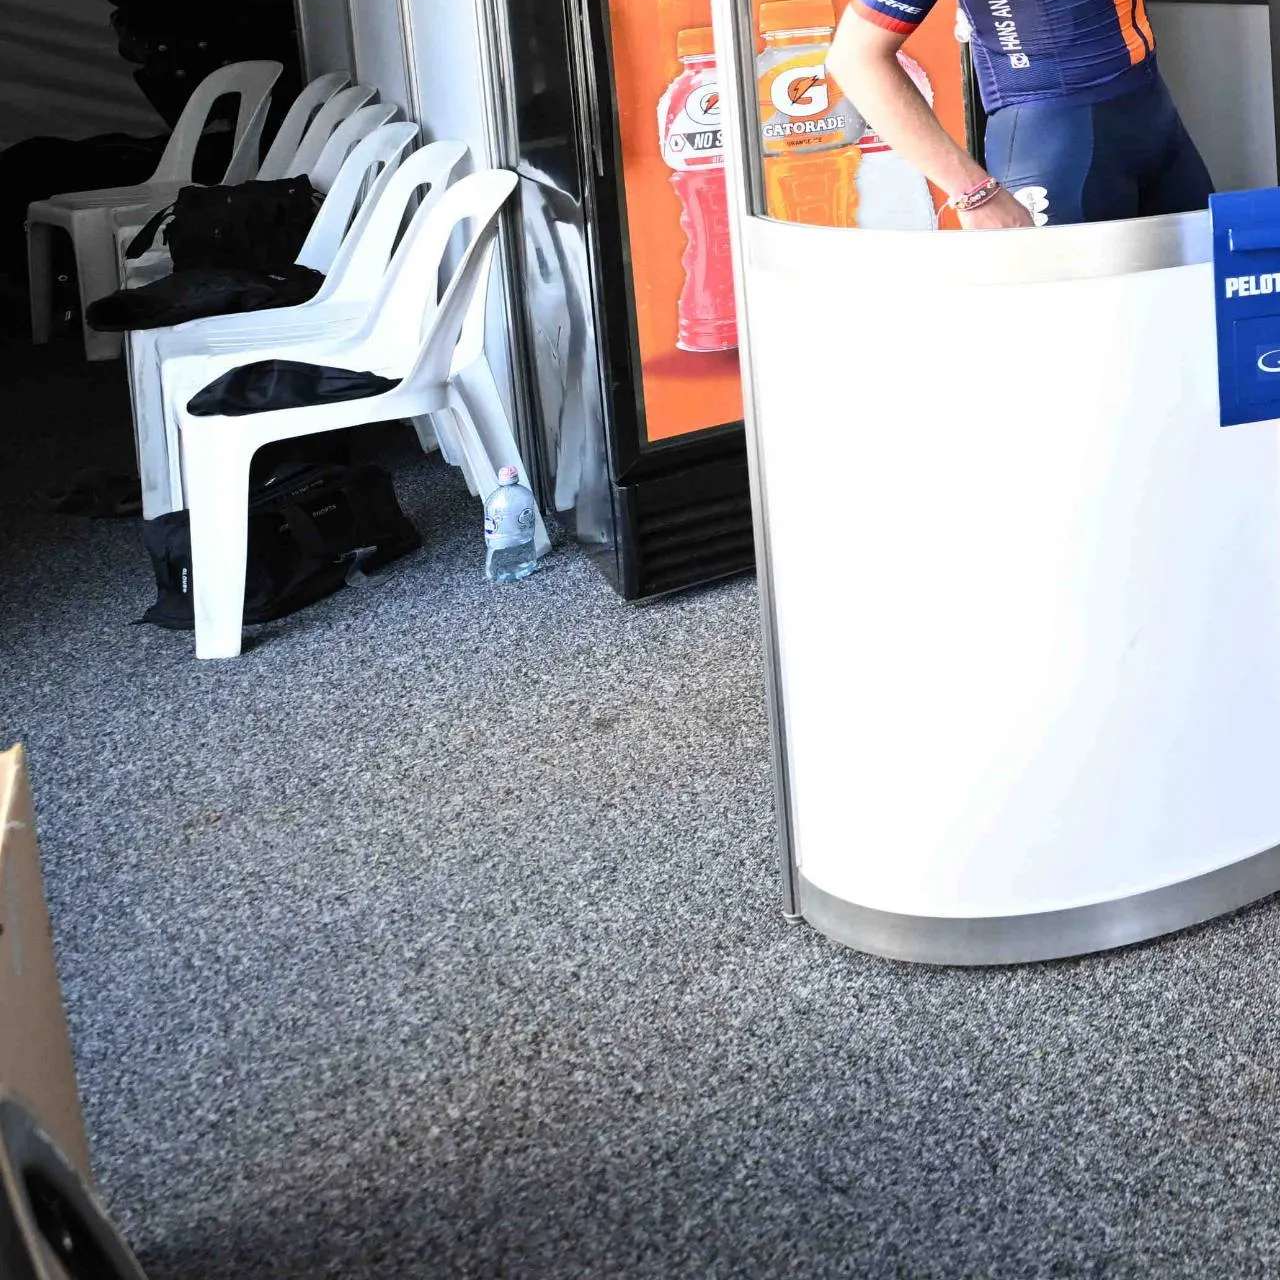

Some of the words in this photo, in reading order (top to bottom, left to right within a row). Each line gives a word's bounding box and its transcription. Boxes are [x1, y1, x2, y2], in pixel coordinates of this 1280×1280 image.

[999, 20, 1021, 51] HANS
[763, 117, 846, 137] GATORADE
[694, 134, 713, 149] NO
